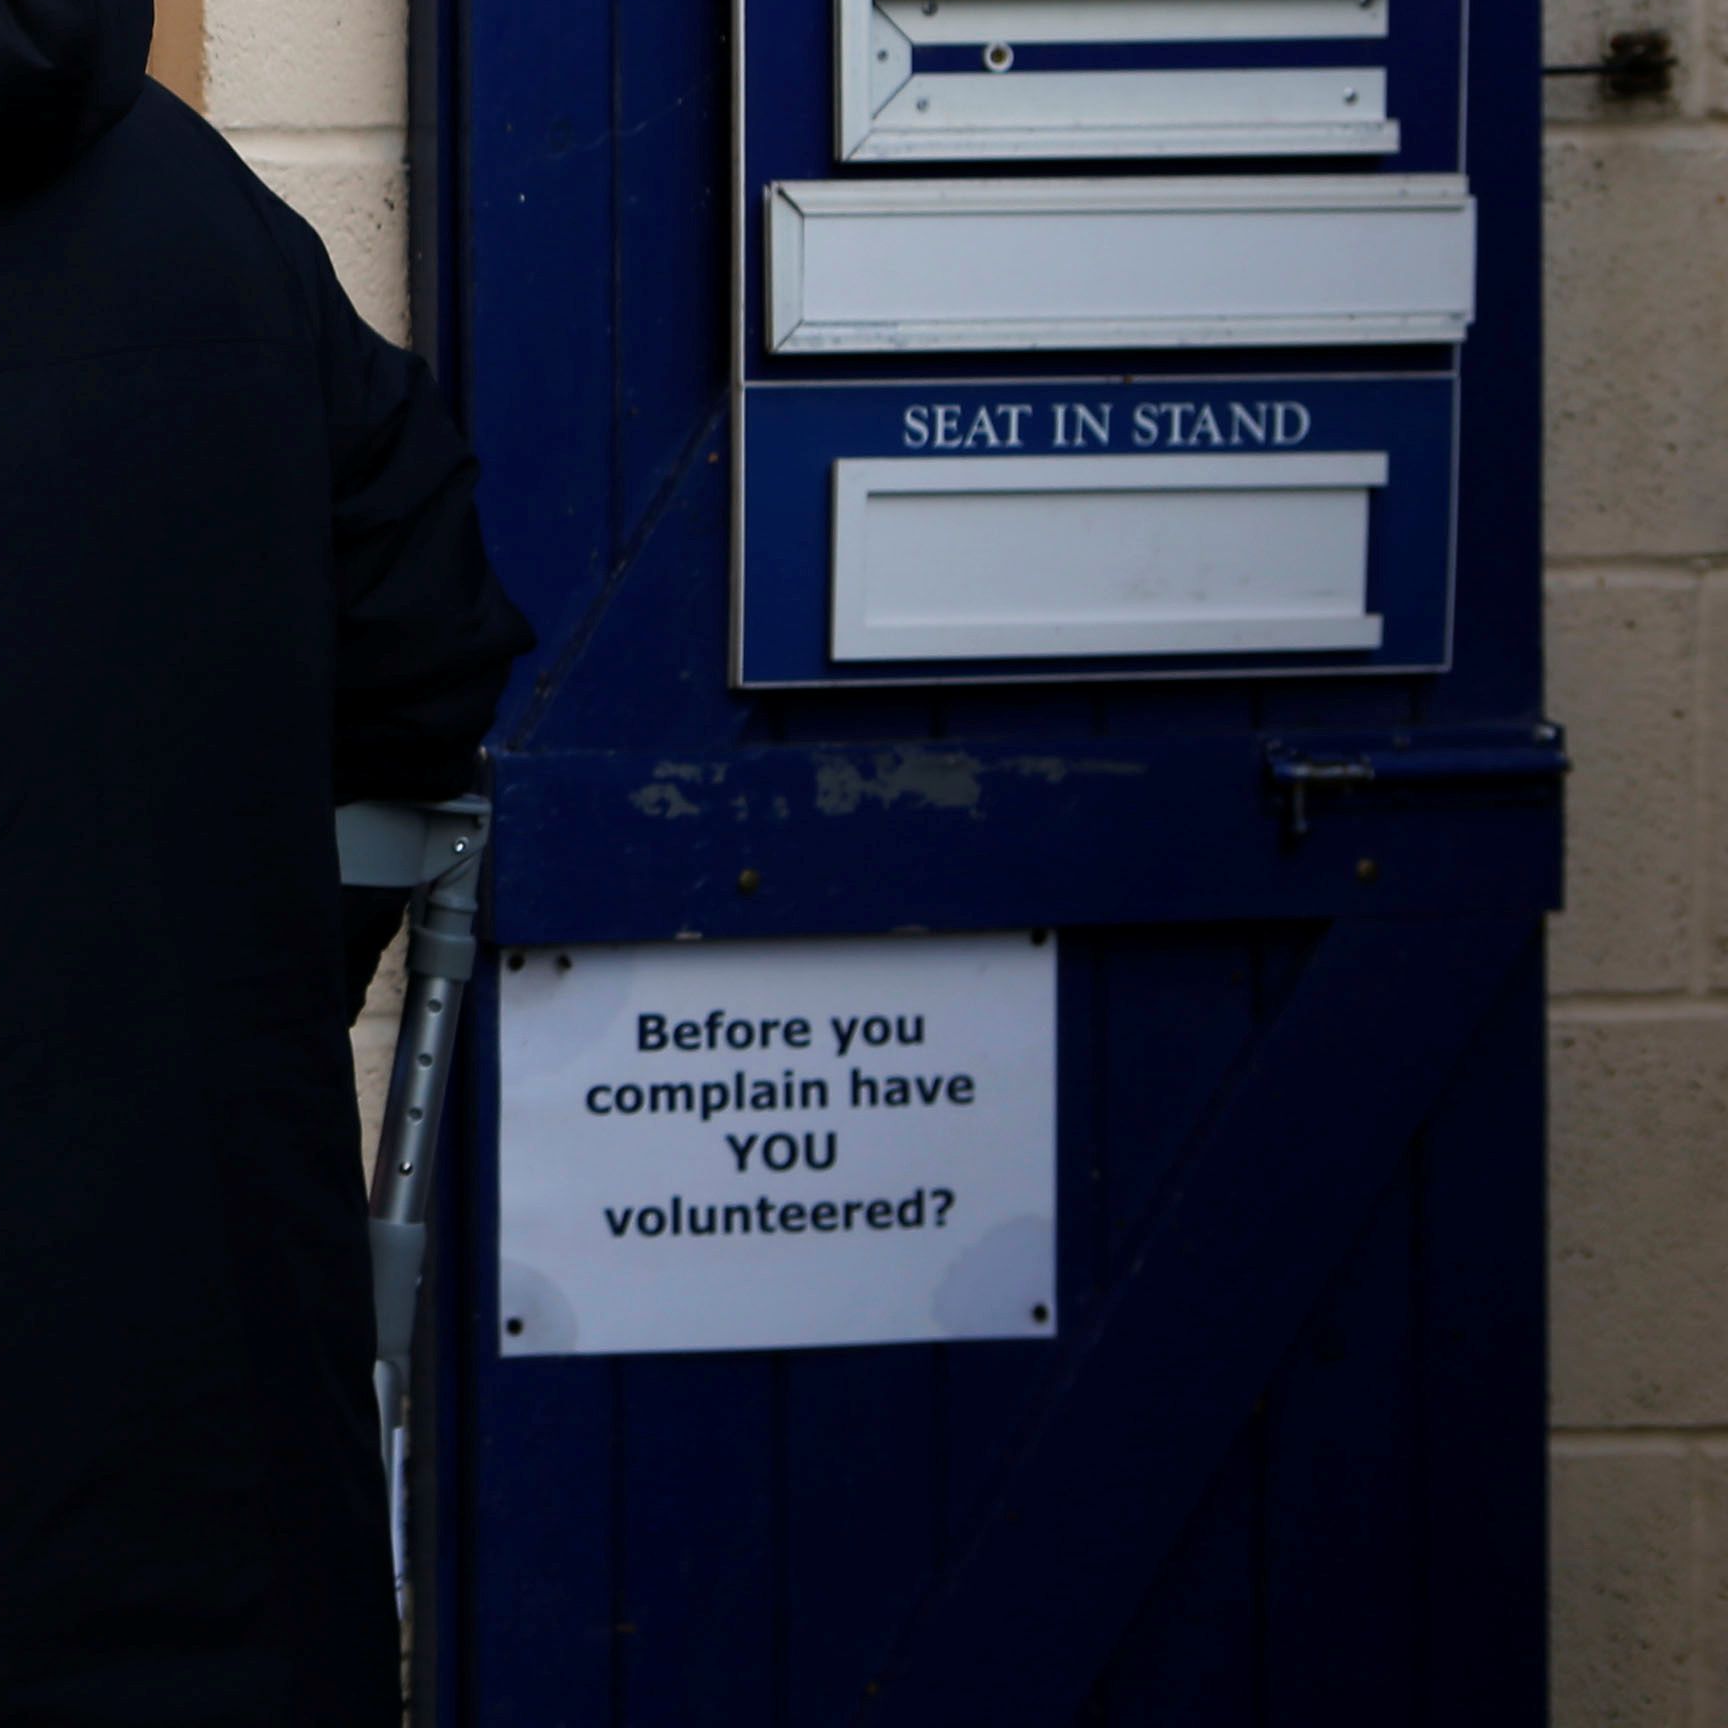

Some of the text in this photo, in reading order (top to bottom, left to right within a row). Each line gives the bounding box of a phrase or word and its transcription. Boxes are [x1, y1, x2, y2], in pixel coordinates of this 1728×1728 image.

[904, 403, 1311, 448] SEAT IN STAND
[637, 1010, 925, 1057] Before you
[585, 1067, 976, 1121] complain have
[725, 1131, 838, 1173] YOU
[604, 1187, 956, 1237] volunteered?
